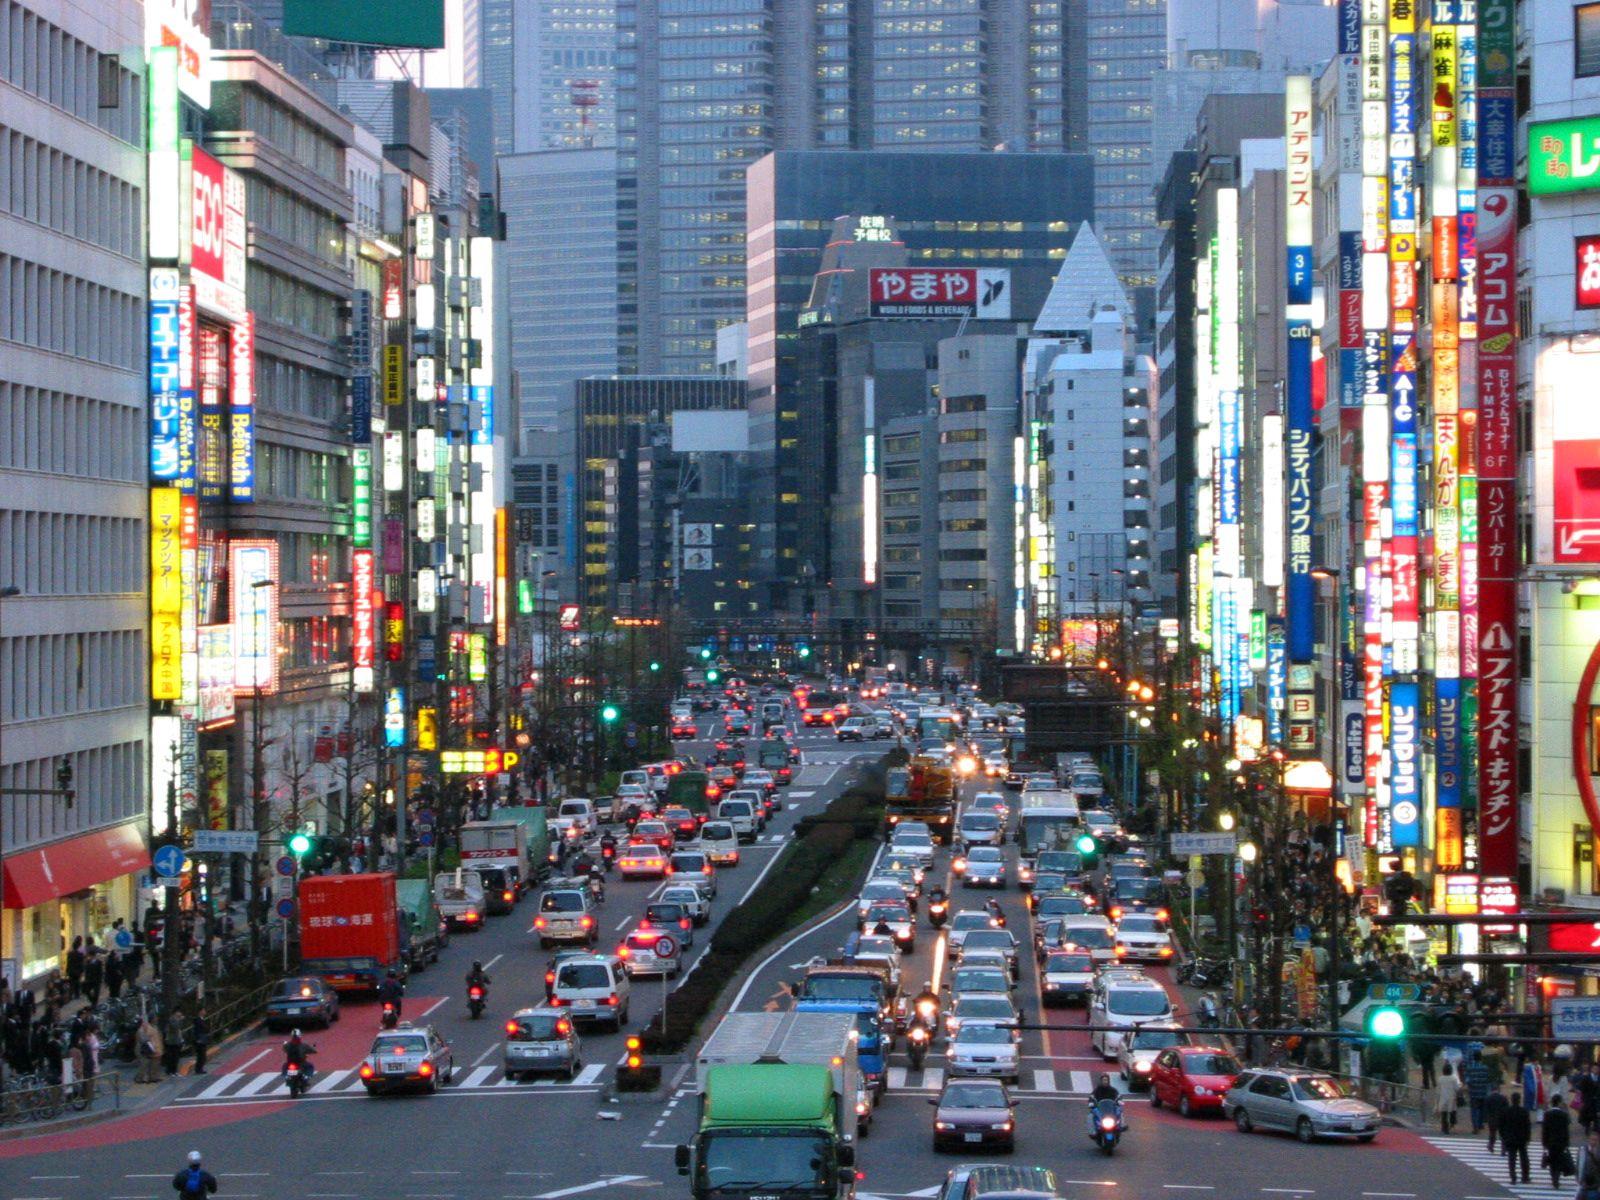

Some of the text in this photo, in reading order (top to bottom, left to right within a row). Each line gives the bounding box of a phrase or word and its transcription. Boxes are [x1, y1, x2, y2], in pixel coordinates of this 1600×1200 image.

[1433, 31, 1453, 77] 麻雀
[1290, 111, 1311, 206] アデランス
[1487, 101, 1505, 175] 大幸住宅
[1571, 132, 1600, 177] レ
[192, 171, 224, 258] ECC
[854, 229, 891, 241] 予備校
[878, 272, 969, 300] やまや
[1348, 294, 1359, 345] クレディア
[1483, 253, 1508, 326] アコム
[1290, 326, 1311, 338] citi
[1484, 369, 1494, 450] ATMコーナー
[1500, 369, 1510, 450] むじんくんコーナー
[1290, 429, 1310, 574] シティバンク銀行
[1488, 488, 1505, 572] ハンバーガー
[1349, 719, 1362, 777] Berlitz
